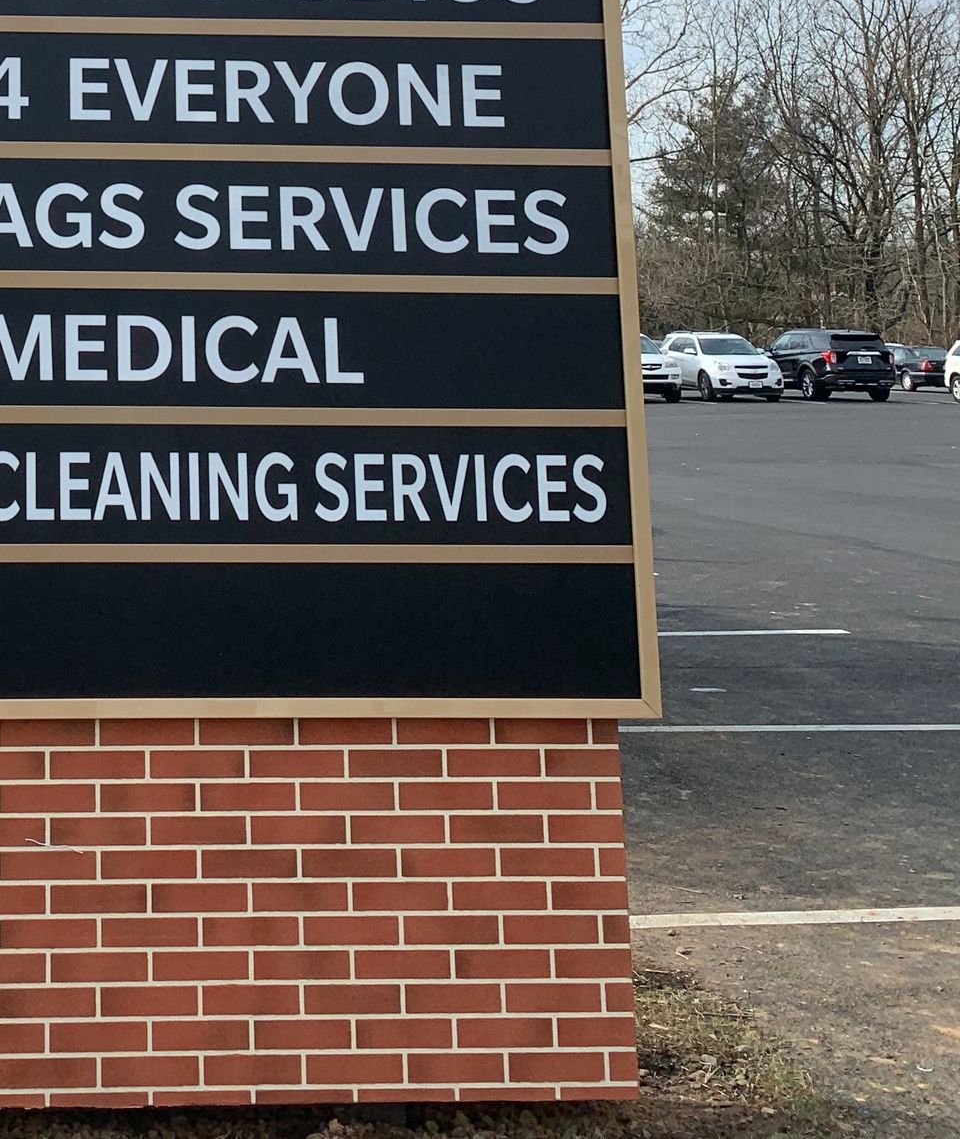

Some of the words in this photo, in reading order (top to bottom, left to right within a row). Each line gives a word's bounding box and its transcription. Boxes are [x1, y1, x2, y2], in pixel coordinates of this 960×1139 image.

[69, 57, 505, 127] EVERYONE
[174, 184, 570, 255] SERVICES
[314, 452, 607, 523] SERVICES
